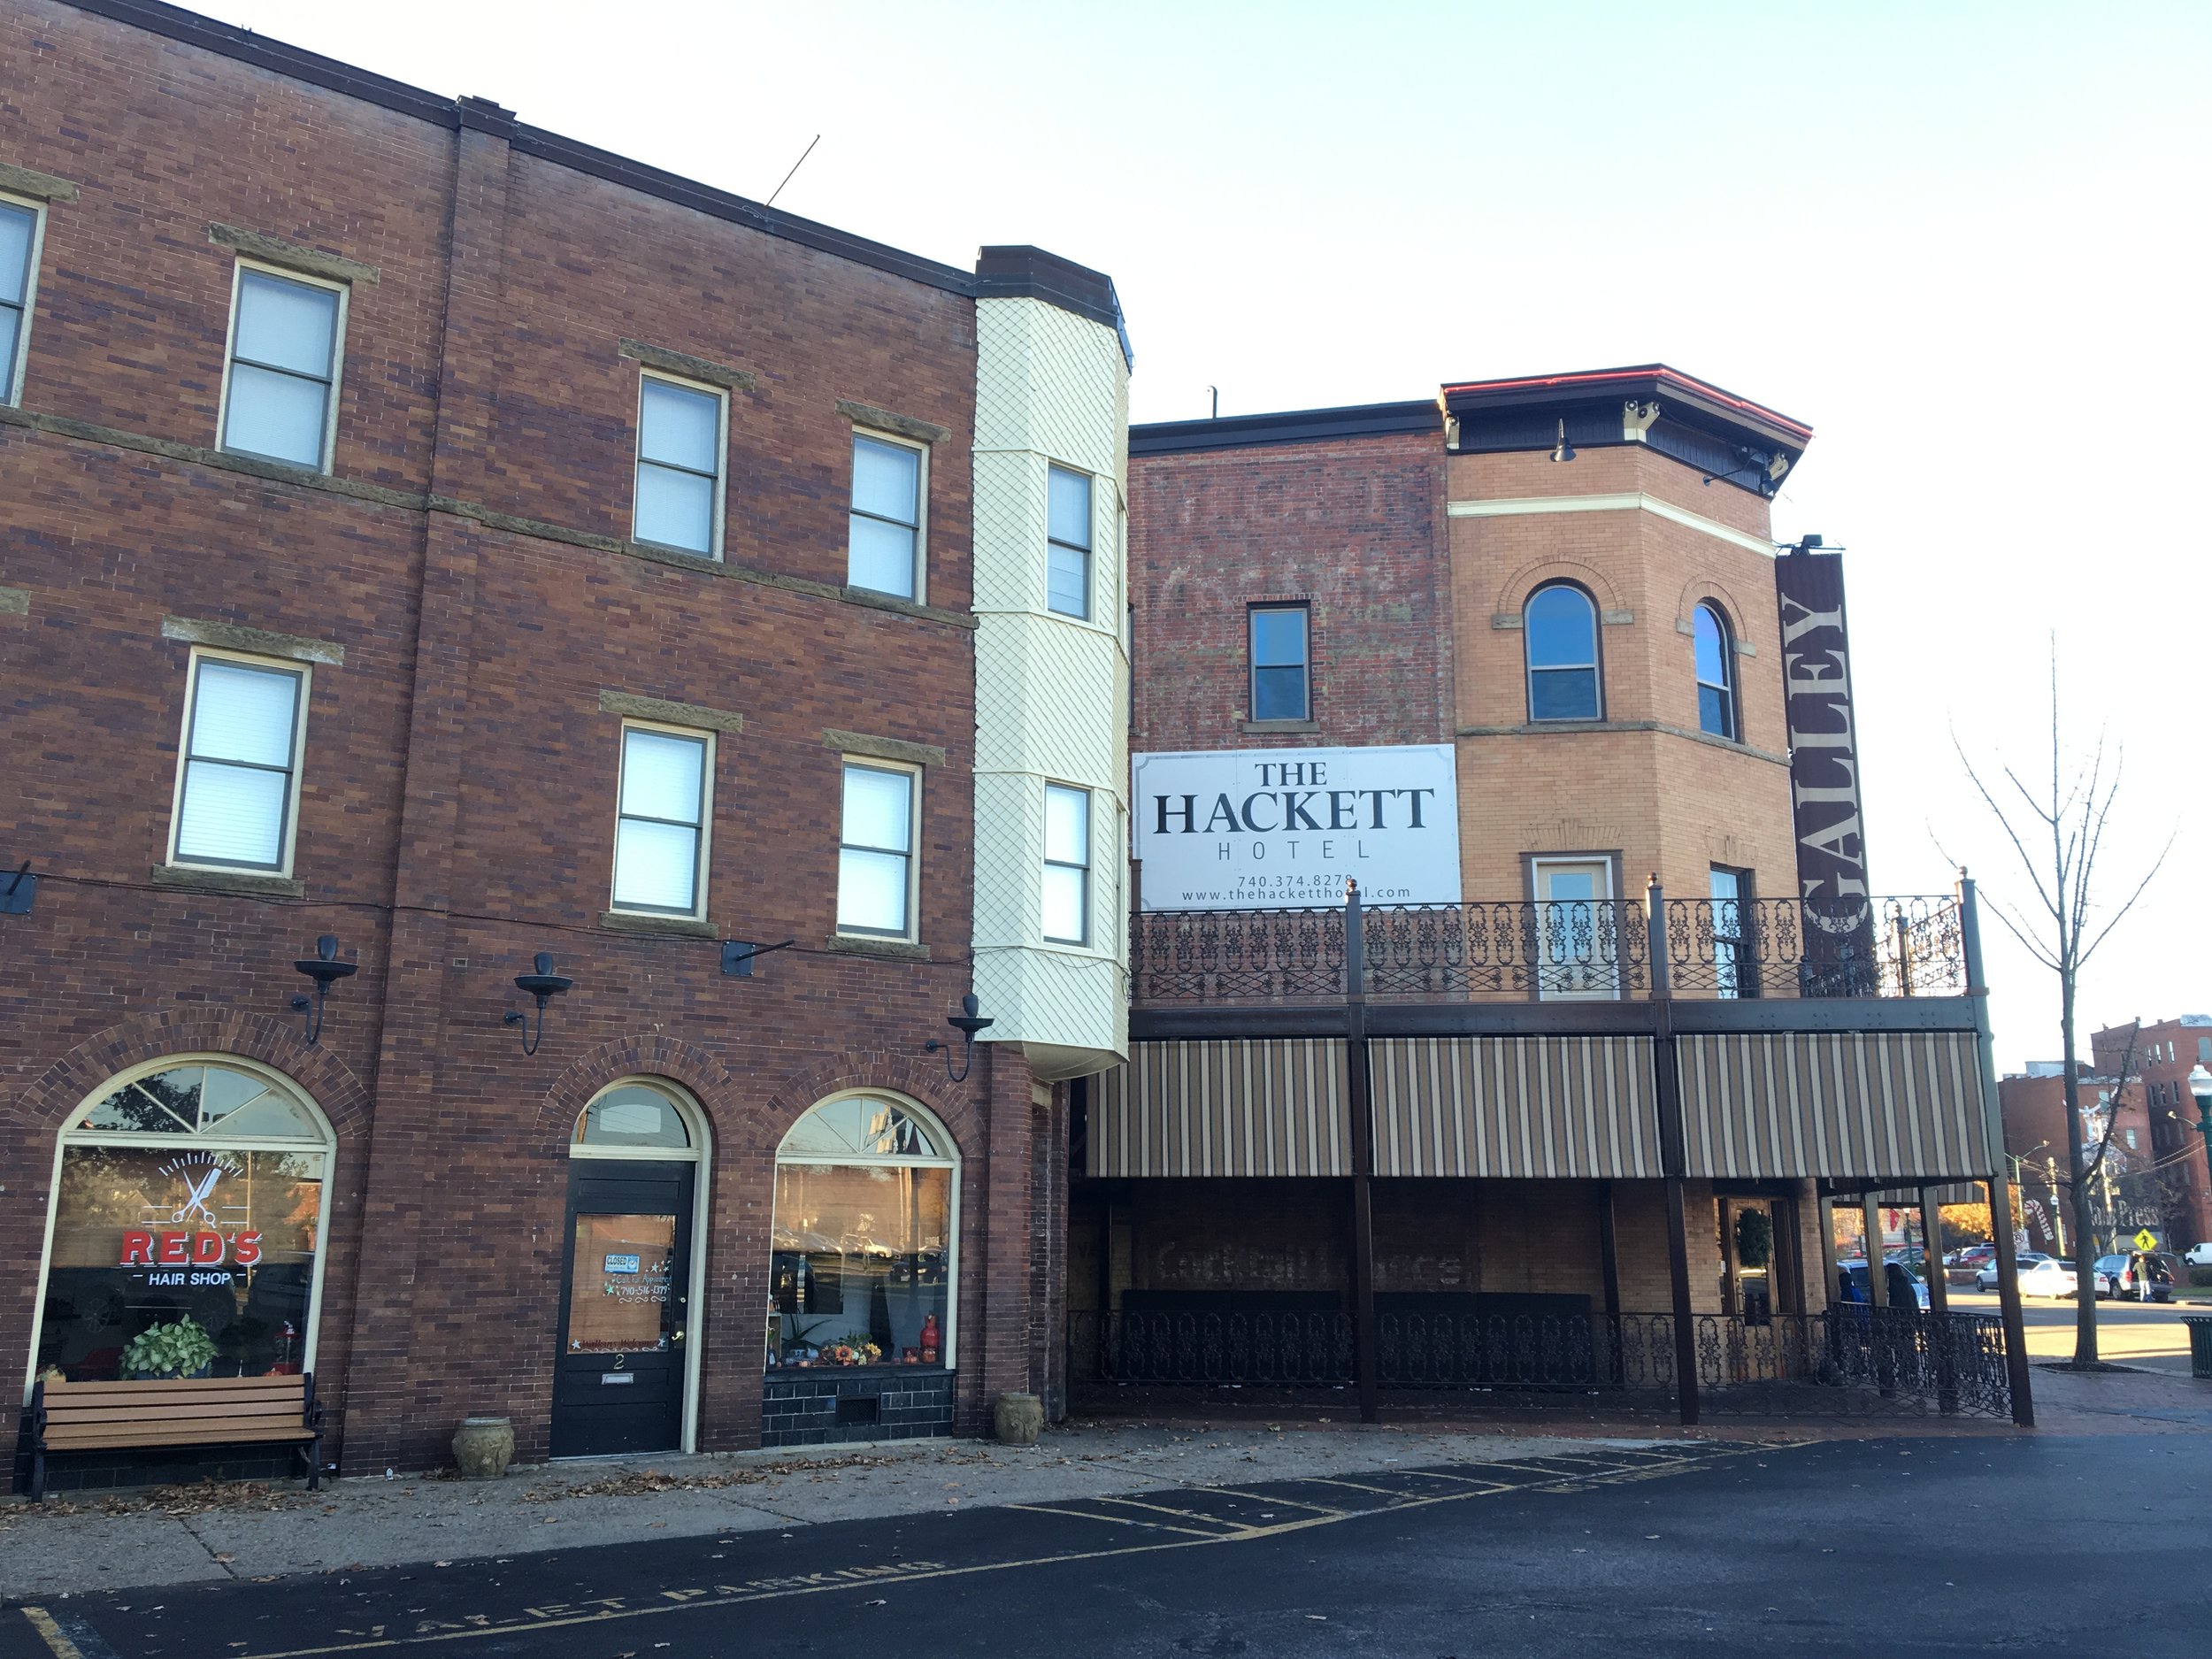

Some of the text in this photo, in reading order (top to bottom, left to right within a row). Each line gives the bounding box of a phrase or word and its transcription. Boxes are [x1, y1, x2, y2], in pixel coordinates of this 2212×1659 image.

[1780, 592, 1869, 934] GALLEY
[1255, 762, 1327, 787] THE
[1153, 787, 1435, 834] HACKETT
[1218, 840, 1370, 861] HOTEL
[1182, 887, 1410, 901] www.thehacketthol.com
[119, 1231, 263, 1267] RED'S
[606, 1256, 627, 1266] CLOSED
[148, 1272, 232, 1286] HAIR SHOP
[613, 1354, 625, 1370] 2
